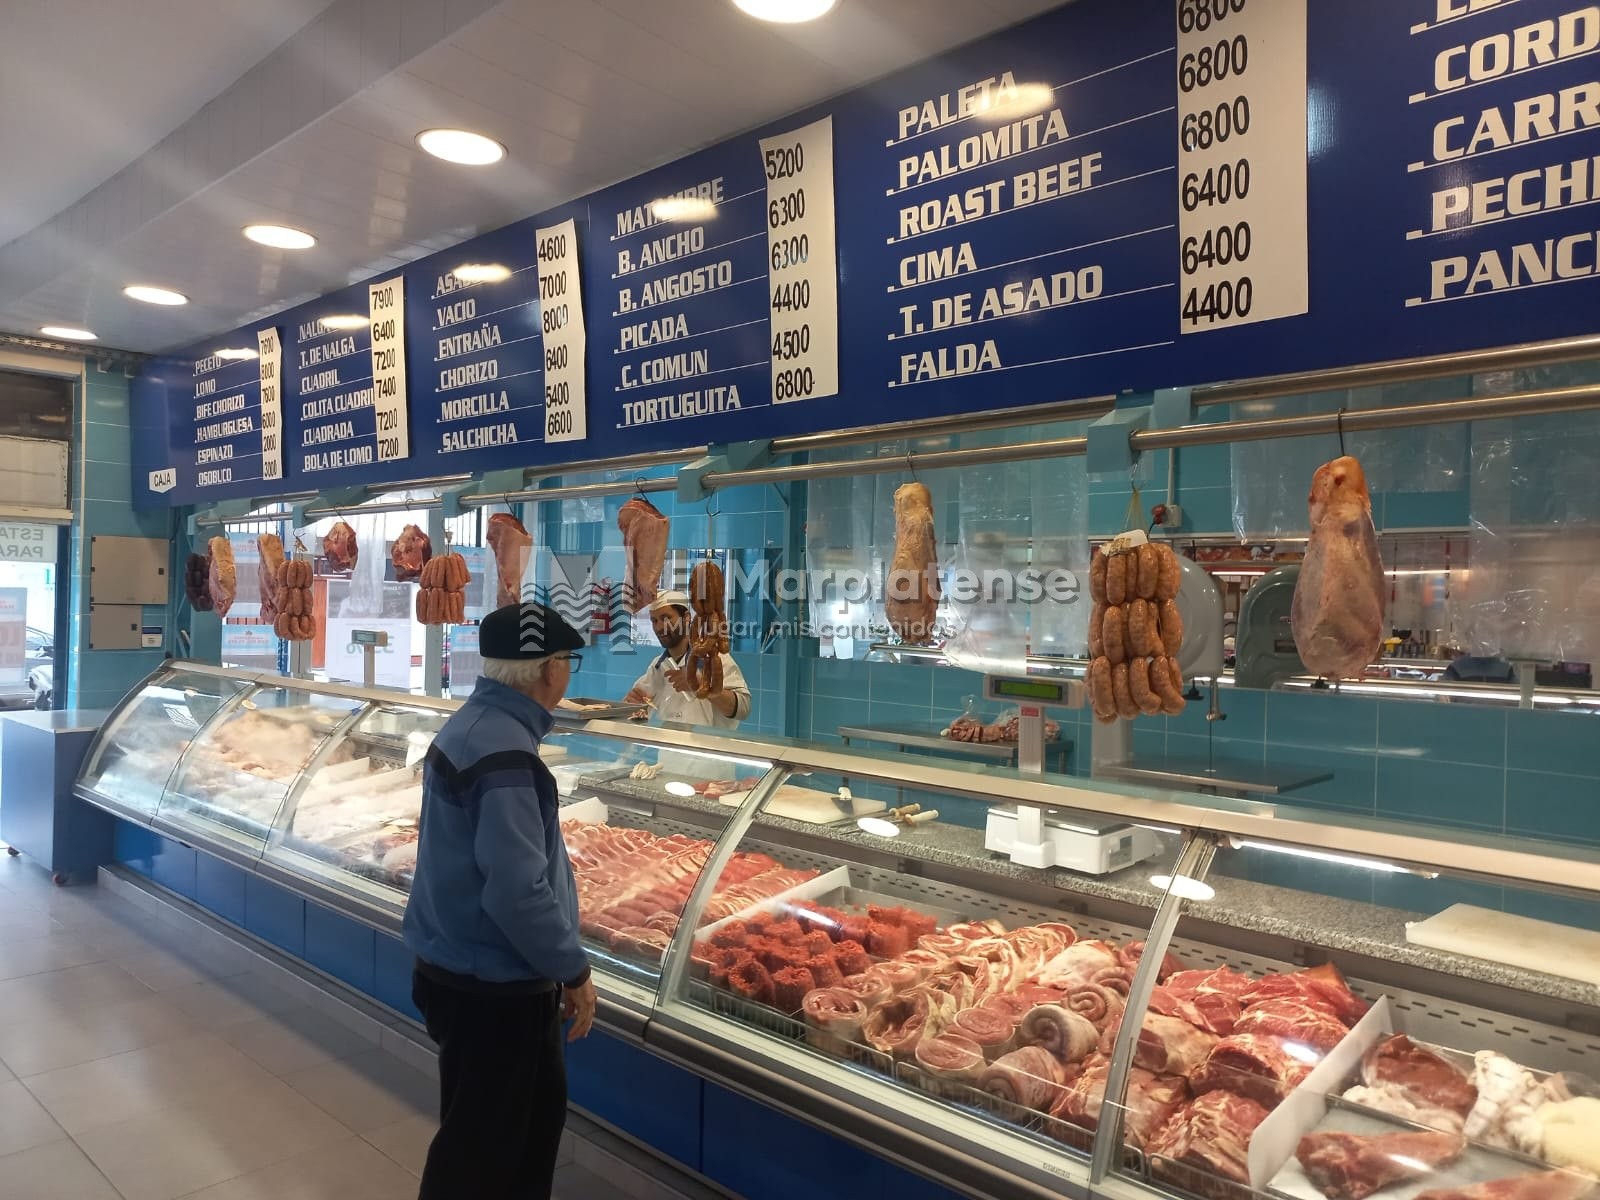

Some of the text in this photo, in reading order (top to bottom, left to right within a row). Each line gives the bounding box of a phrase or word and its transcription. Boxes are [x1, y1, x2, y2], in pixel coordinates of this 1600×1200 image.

[1179, 34, 1248, 92] 6800
[1434, 6, 1600, 91] CORD
[899, 71, 1018, 140] PALETA
[1433, 81, 1600, 161] CARR
[1181, 95, 1250, 153] 6800
[765, 143, 804, 180] 5200
[899, 109, 1070, 188] PALOMITA
[900, 152, 1102, 240] ROAST BEEF
[1182, 158, 1250, 212] 6400
[617, 176, 724, 236] MATRE
[769, 188, 805, 229] 6300
[538, 234, 566, 262] 4600
[618, 226, 705, 275] B. ANCHO
[771, 234, 808, 271] 6300
[1181, 221, 1251, 275] 6400
[900, 242, 977, 287] CIMA
[436, 265, 482, 296] ASA
[539, 270, 567, 300] 7000
[619, 260, 732, 313] B. ANGOSTO
[772, 279, 810, 313] 4400
[372, 286, 394, 311] 7900
[437, 298, 476, 327] VACIO
[900, 265, 1103, 336] T. DE ASADO
[1182, 277, 1252, 325] 4400
[373, 319, 396, 342] 6400
[543, 304, 569, 333] 8000
[620, 313, 689, 351] PICADA
[300, 336, 356, 367] T. DE NALGA
[439, 322, 502, 360] ENTRAÑA
[772, 324, 810, 361] 4500
[374, 347, 396, 371] 7200
[546, 344, 568, 371] 6400
[622, 349, 708, 389] C. COMUN
[901, 339, 1002, 383] FALDA
[196, 378, 216, 397] LOMO
[301, 369, 340, 393] CUADRIL
[376, 375, 397, 399] 7400
[440, 359, 498, 390] CHORIZO
[775, 367, 814, 401] 6800
[196, 394, 245, 419] BIFE CHORIZO
[302, 387, 375, 419] COLITA CUADRIL
[441, 390, 510, 421] MORCILLA
[546, 381, 570, 409] 5400
[623, 385, 741, 425] TORTUGUITA
[196, 416, 253, 441] HAMBURGUESA
[303, 420, 354, 445] CUADRADA
[377, 407, 398, 432] 7200
[548, 410, 572, 436] 6600
[264, 434, 277, 451] 2000
[379, 437, 399, 459] 7200
[442, 422, 518, 451] SALCHICHA
[197, 444, 233, 463] ESPINAZO
[304, 444, 373, 470] BOLA DE LOMO
[153, 474, 171, 487] CAJA
